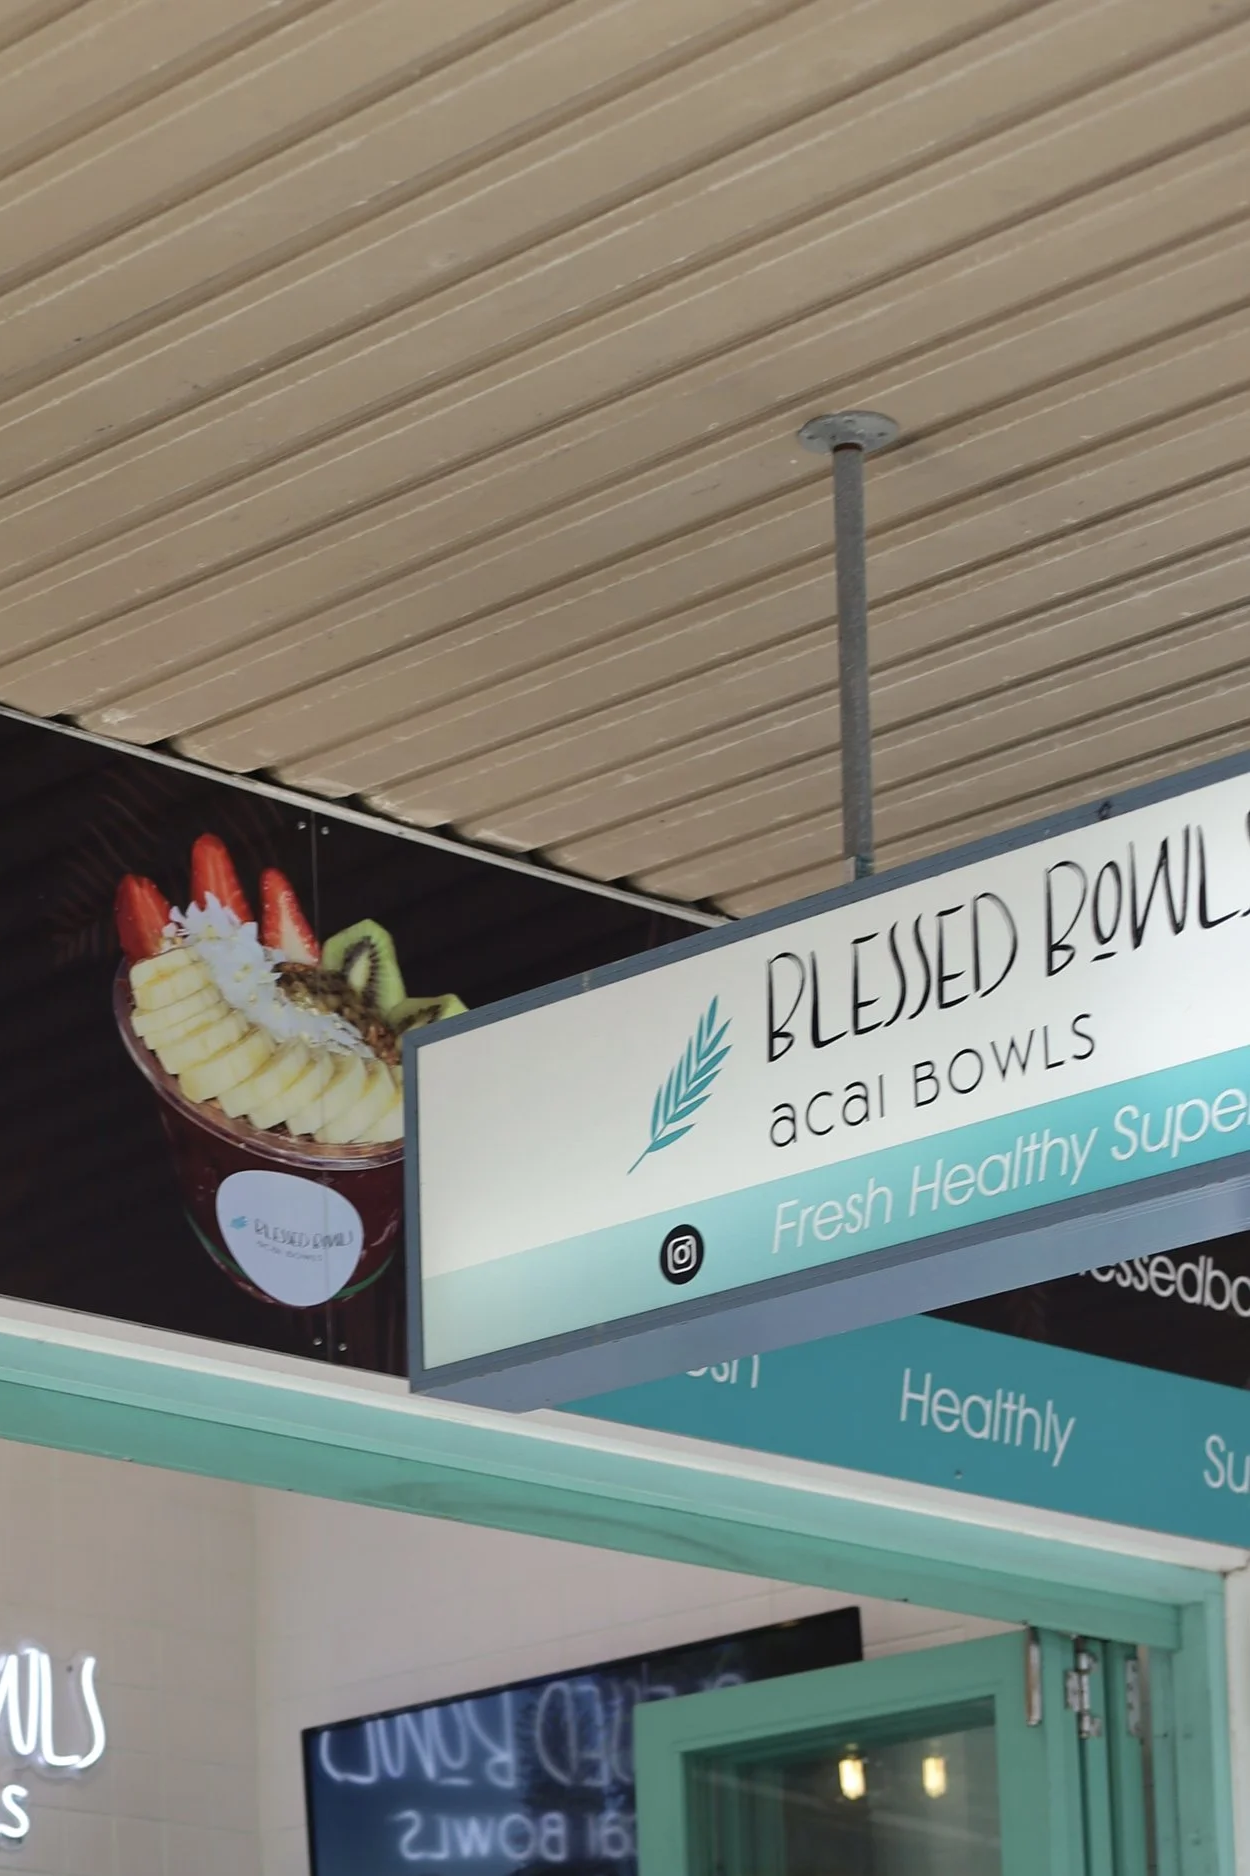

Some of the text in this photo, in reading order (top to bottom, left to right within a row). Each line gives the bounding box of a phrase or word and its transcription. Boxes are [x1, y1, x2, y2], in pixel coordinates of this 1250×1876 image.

[765, 806, 1250, 1063] BLESSED BOWL
[912, 1012, 1096, 1108] BOWLS
[771, 1087, 1250, 1254] Fresh Healthy Supe
[899, 1368, 1075, 1467] Healthly
